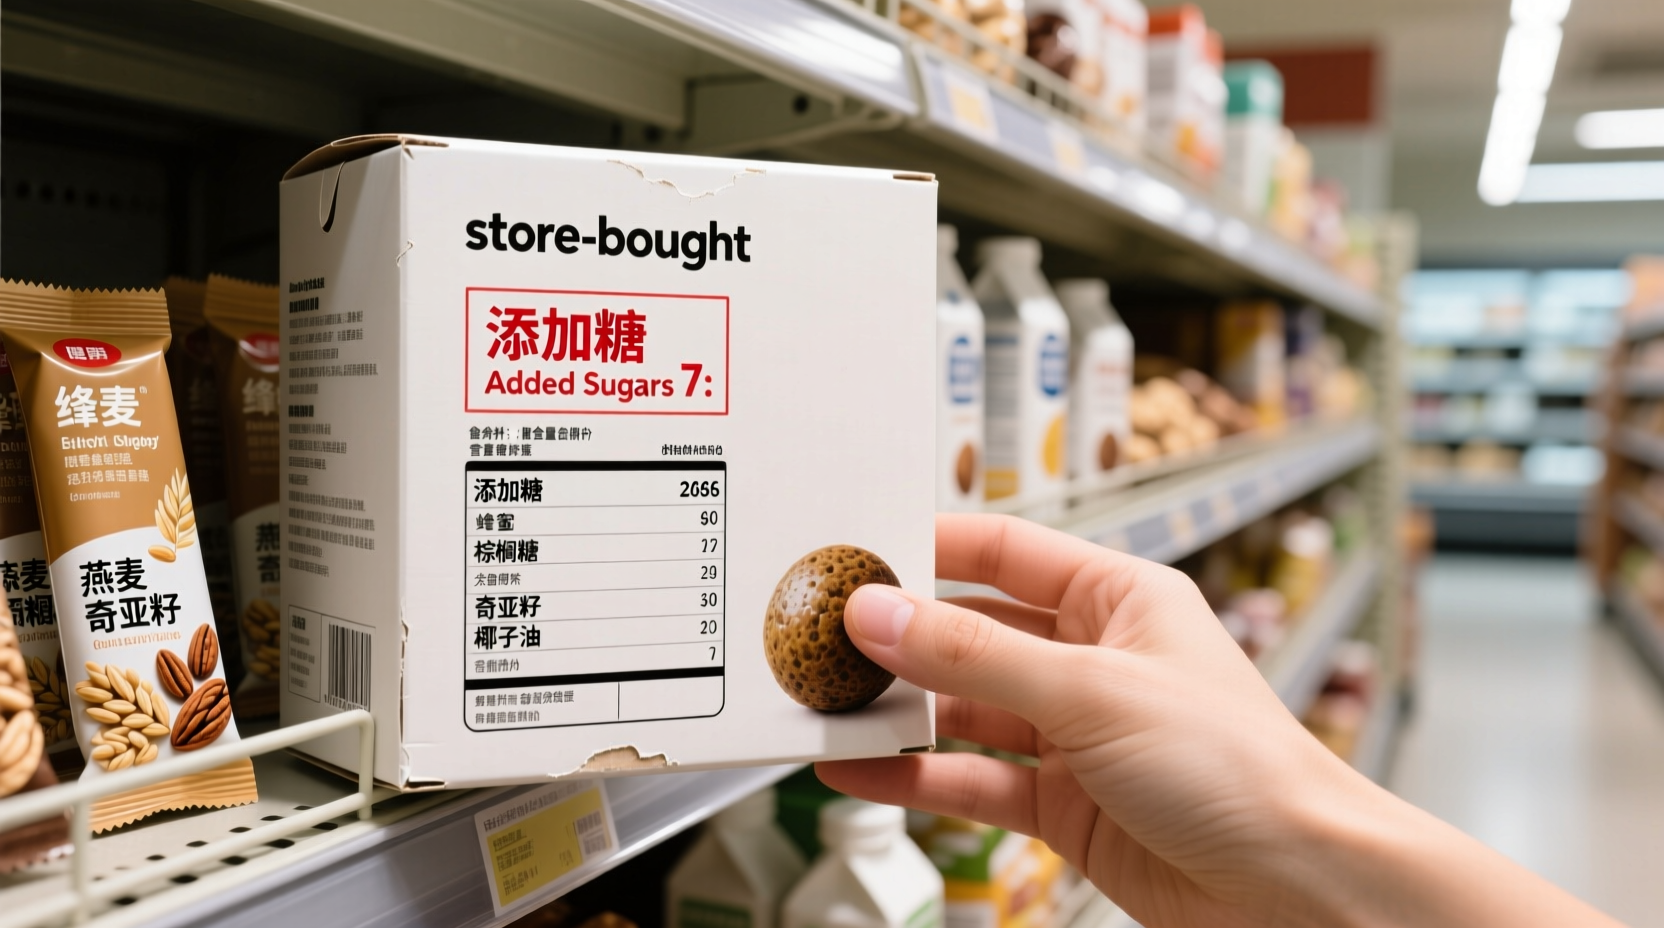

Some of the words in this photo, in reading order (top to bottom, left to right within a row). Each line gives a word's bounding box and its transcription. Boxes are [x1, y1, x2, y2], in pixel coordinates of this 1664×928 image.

[466, 213, 751, 271] store-bought
[486, 306, 647, 363] 添加糖
[485, 370, 574, 395] Added
[584, 372, 674, 403] Sugars
[681, 363, 712, 397] 7:
[474, 477, 543, 503] 添加糖
[79, 558, 147, 597] 燕麦
[701, 565, 717, 579] 29
[83, 590, 181, 633] 奇亚籽
[475, 594, 541, 620] 奇亚籽
[701, 593, 717, 607] 30
[474, 624, 540, 650] 椰子油
[701, 620, 717, 634] 20
[709, 647, 716, 660] 7
